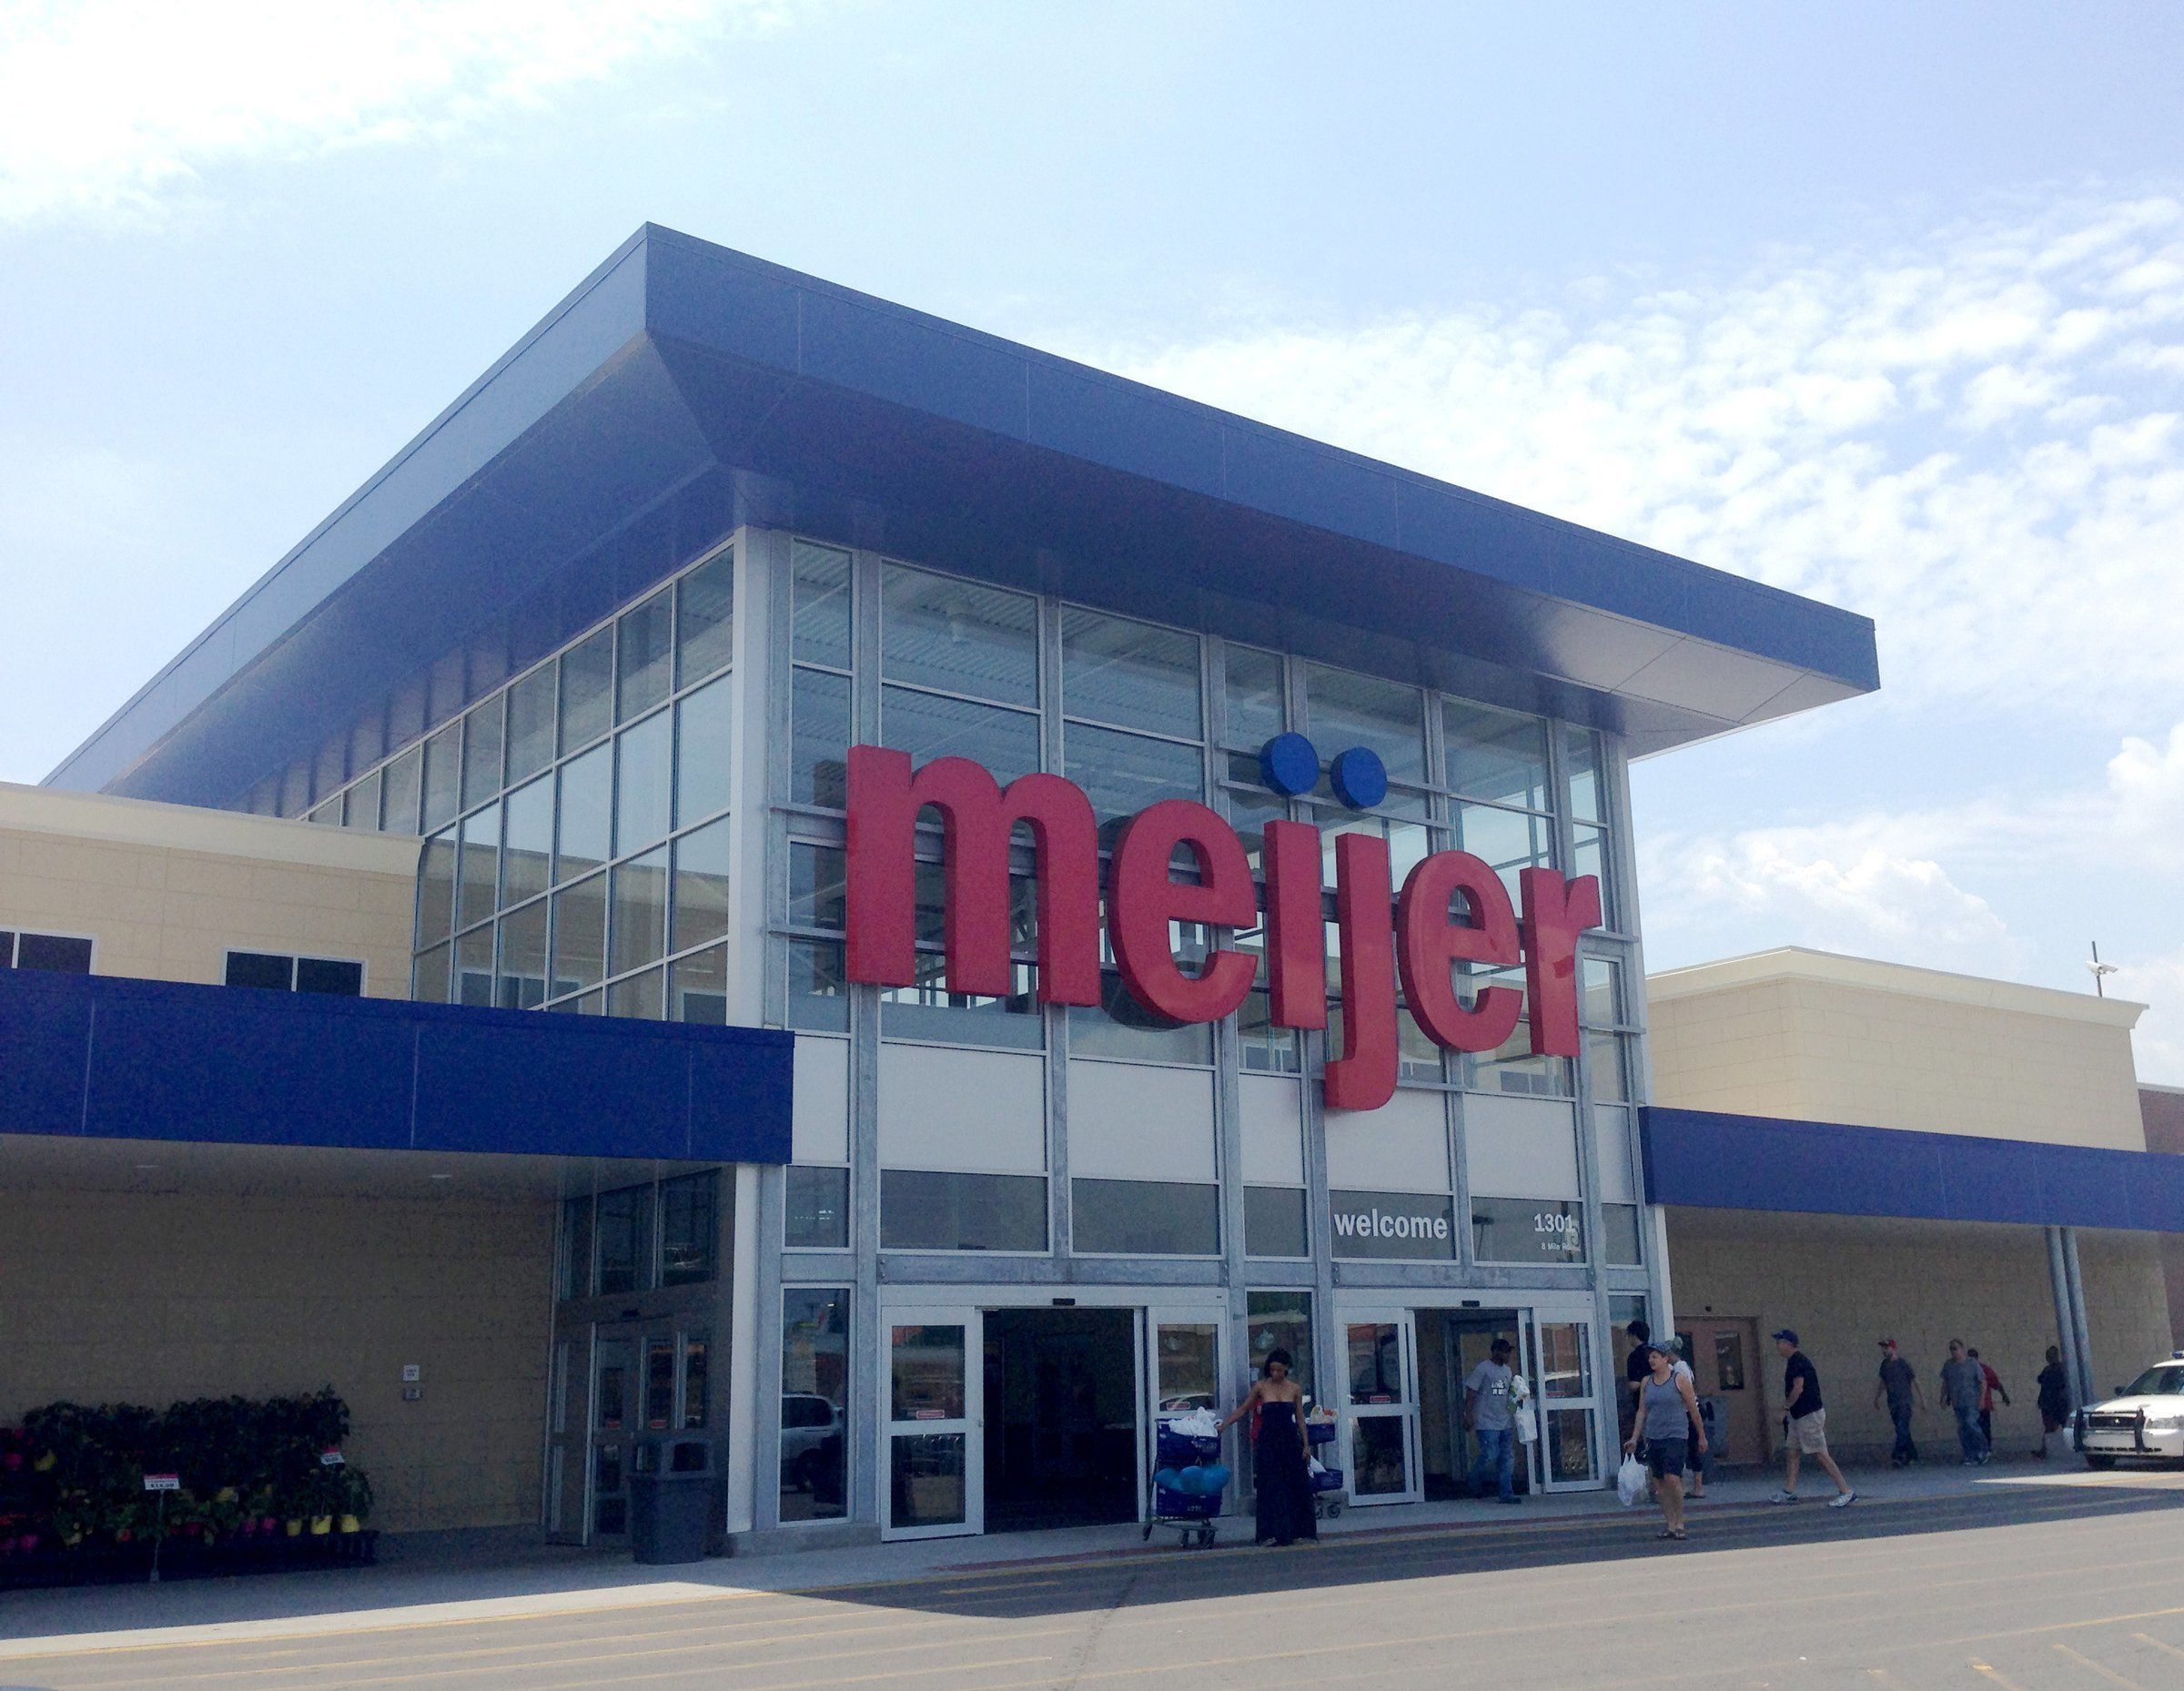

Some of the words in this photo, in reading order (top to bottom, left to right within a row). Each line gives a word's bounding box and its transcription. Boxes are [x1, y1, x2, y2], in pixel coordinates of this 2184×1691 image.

[845, 731, 1602, 1111] meijer
[1333, 1209, 1449, 1240] welcome
[1533, 1212, 1576, 1233] 1301
[1541, 1241, 1546, 1251] 8
